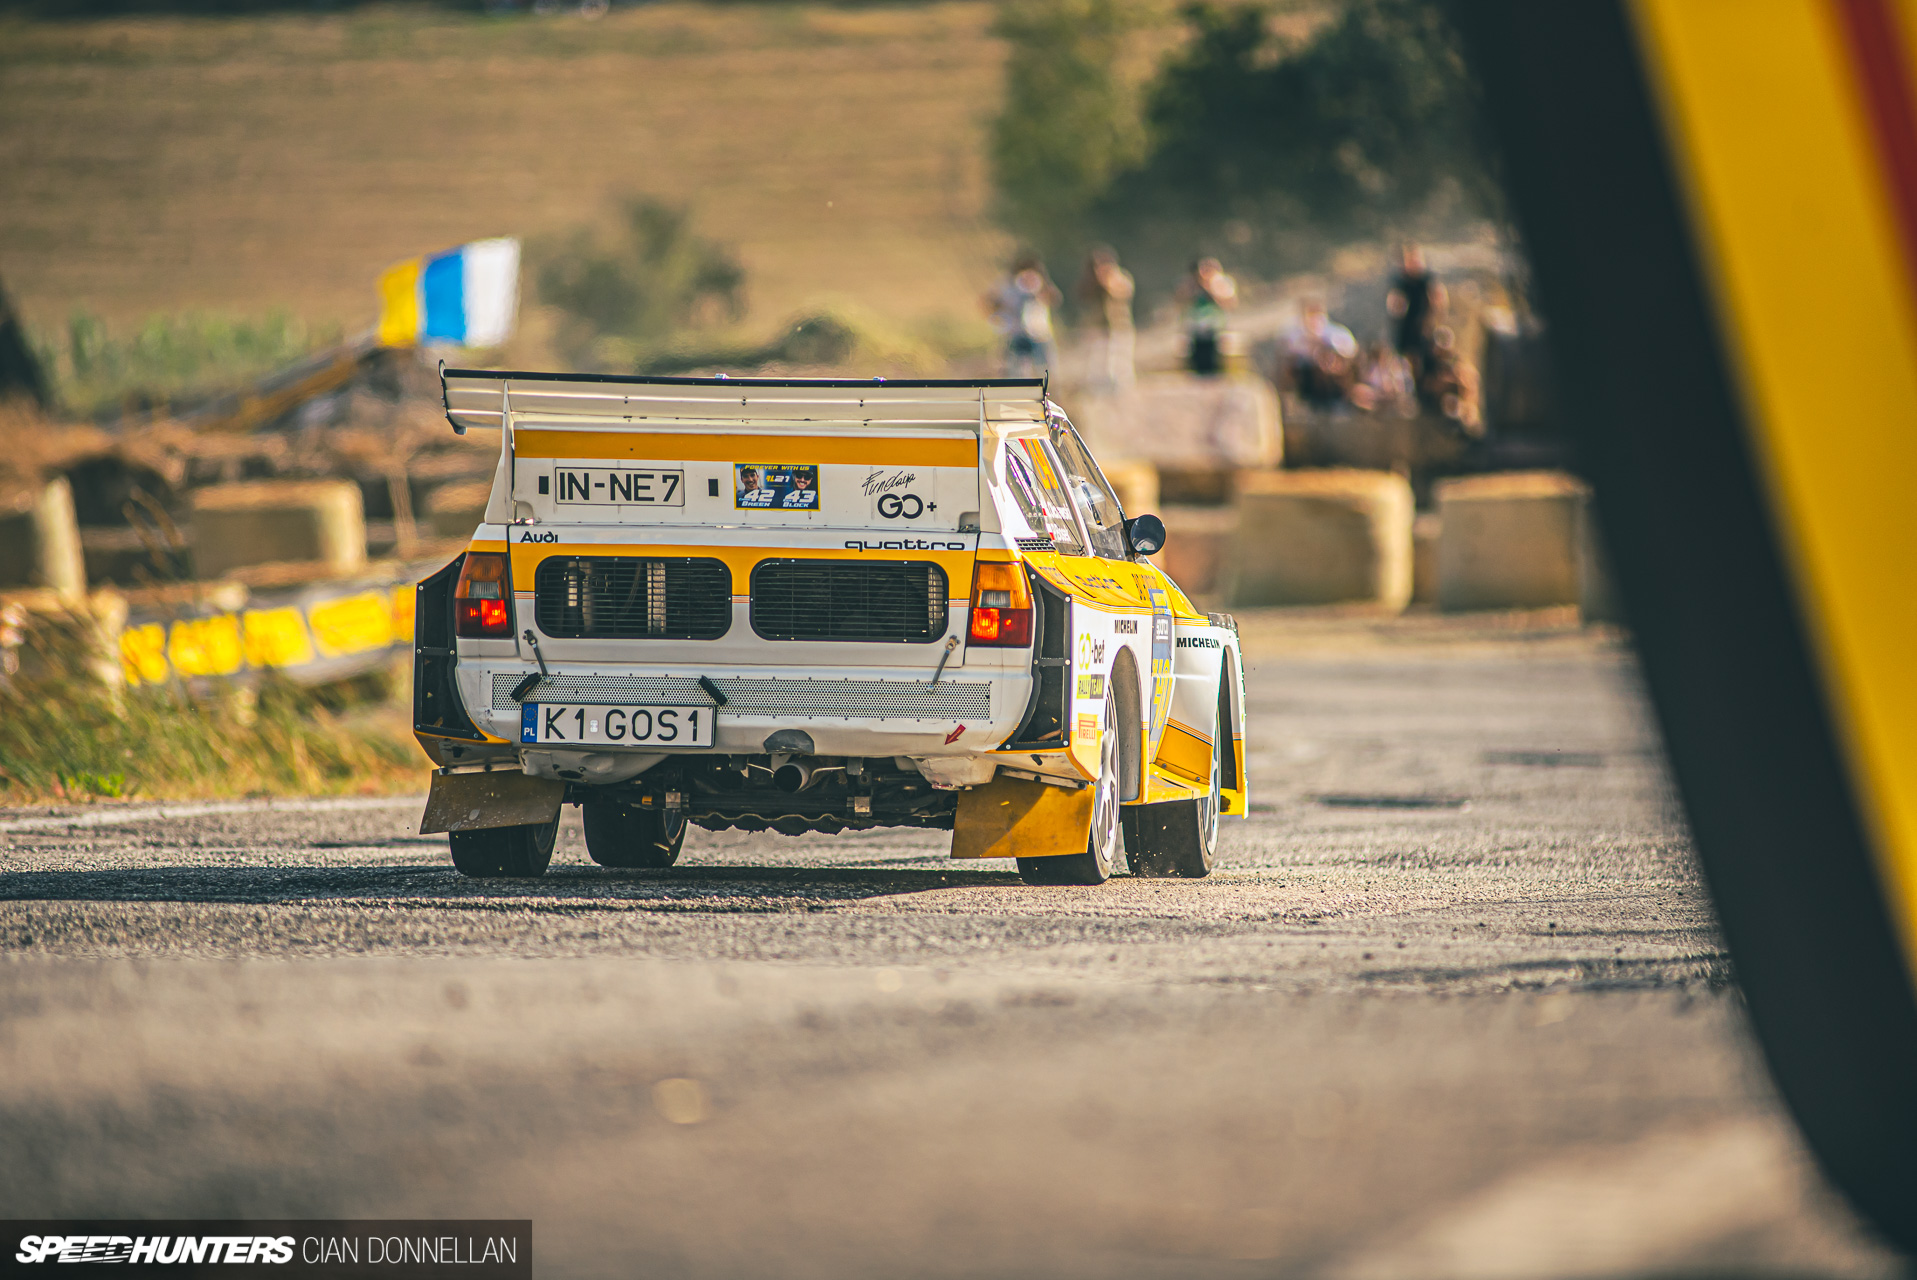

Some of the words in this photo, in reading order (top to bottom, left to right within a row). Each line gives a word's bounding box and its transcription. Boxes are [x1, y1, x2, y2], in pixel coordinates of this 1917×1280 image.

[745, 489, 775, 502] 42
[785, 489, 816, 503] 43
[520, 531, 558, 543] Audi
[844, 539, 966, 552] quattro
[1115, 620, 1138, 635] MICHELIN
[1177, 638, 1220, 649] MICHELIN
[1079, 680, 1090, 695] RALLY
[1091, 680, 1103, 695] TEAM
[524, 728, 535, 737] PL
[1078, 719, 1096, 740] PIRELLI
